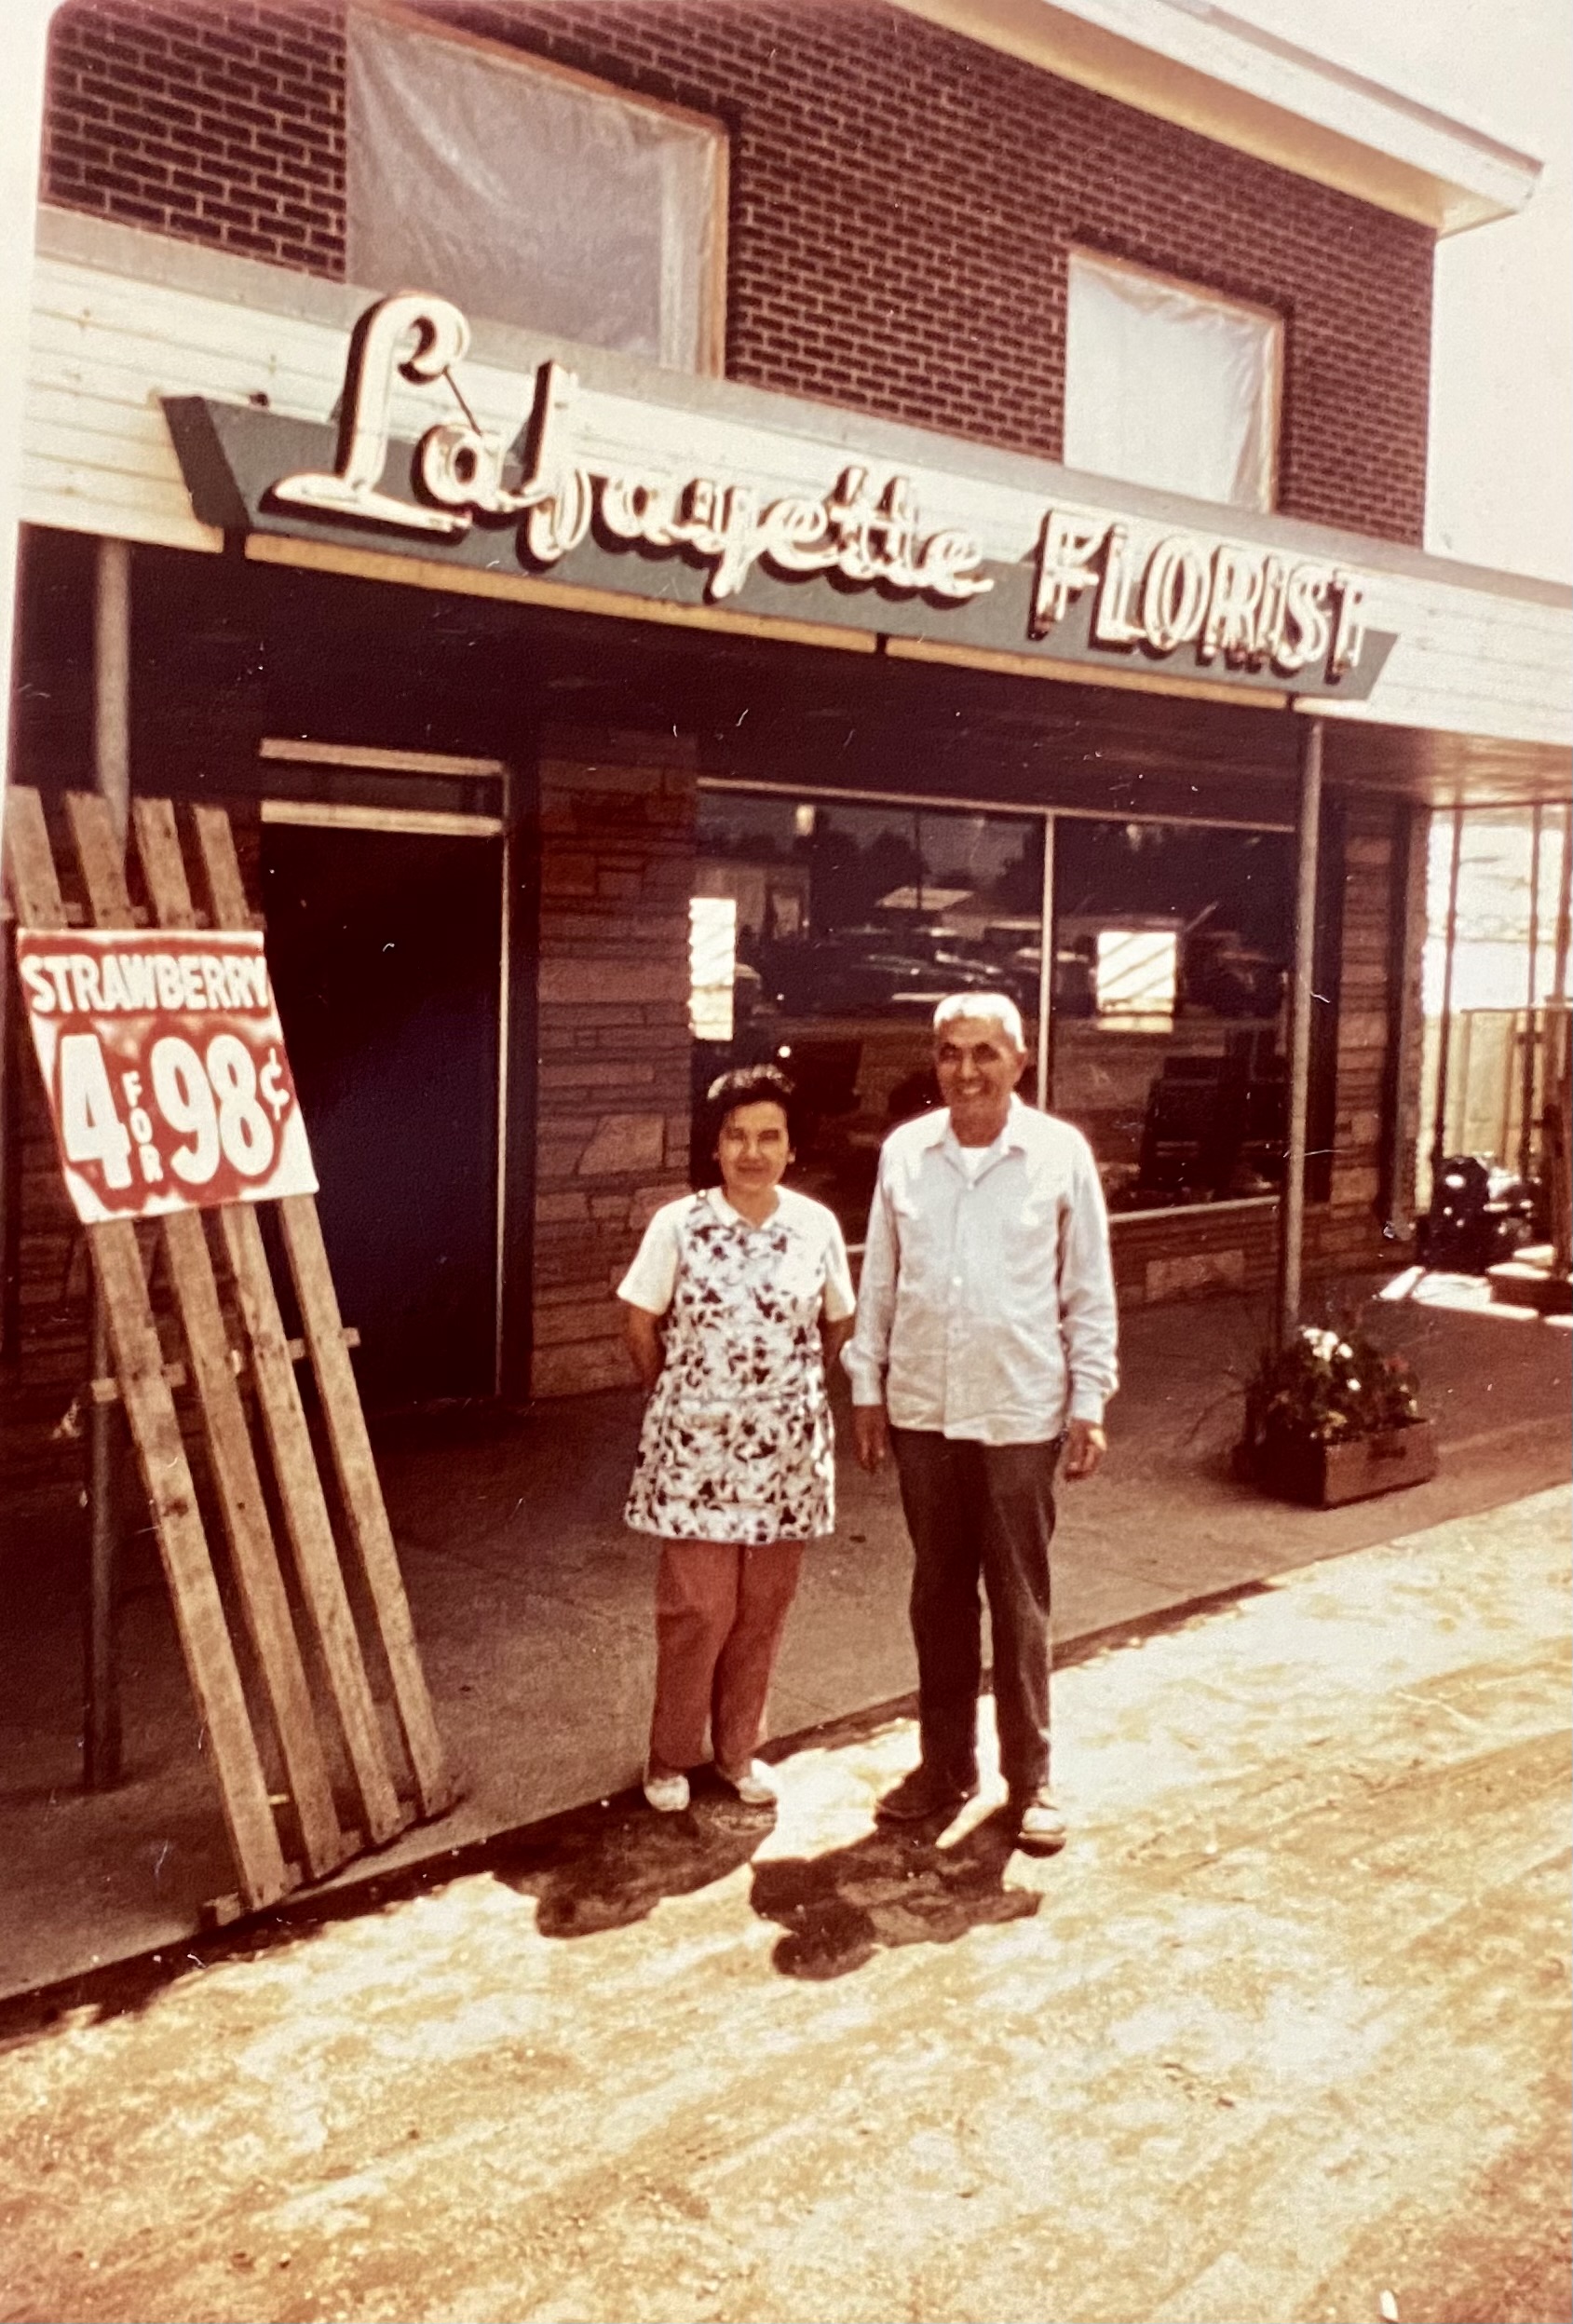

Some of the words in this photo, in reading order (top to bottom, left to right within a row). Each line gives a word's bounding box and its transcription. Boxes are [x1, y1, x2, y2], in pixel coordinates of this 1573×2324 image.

[270, 290, 995, 602] Lafayette
[1032, 510, 1365, 685] FLORIST
[20, 954, 268, 1013] STRAWBERRY
[61, 1033, 132, 1189] 4
[122, 1071, 164, 1183] FOR
